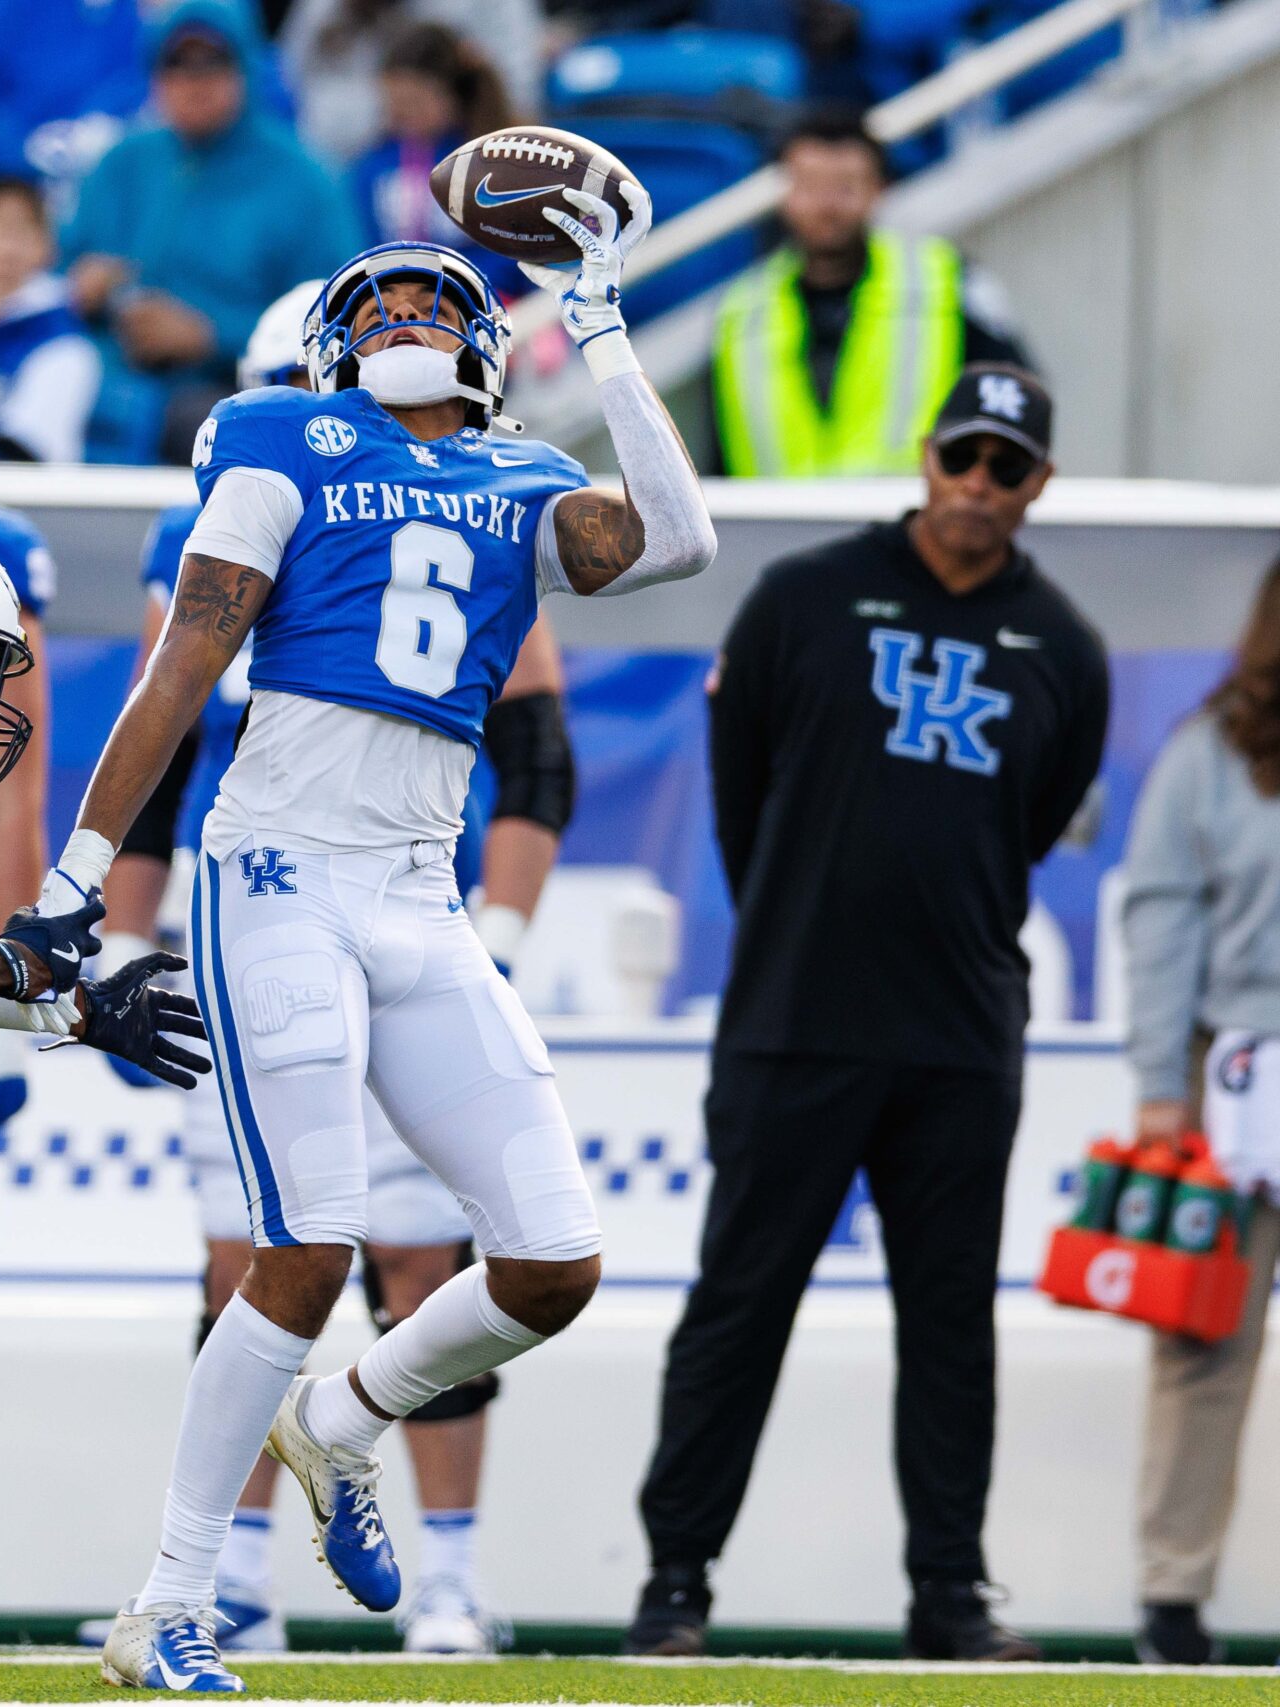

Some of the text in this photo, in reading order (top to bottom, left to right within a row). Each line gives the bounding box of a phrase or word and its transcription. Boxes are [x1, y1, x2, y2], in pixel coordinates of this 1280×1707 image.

[559, 215, 605, 259] KENTUCKY
[311, 418, 355, 453] SEC
[322, 482, 527, 544] KENTUCKY
[375, 520, 475, 699] 6
[869, 626, 1013, 777] UK
[239, 847, 298, 898] UK
[19, 960, 29, 990] PSALM
